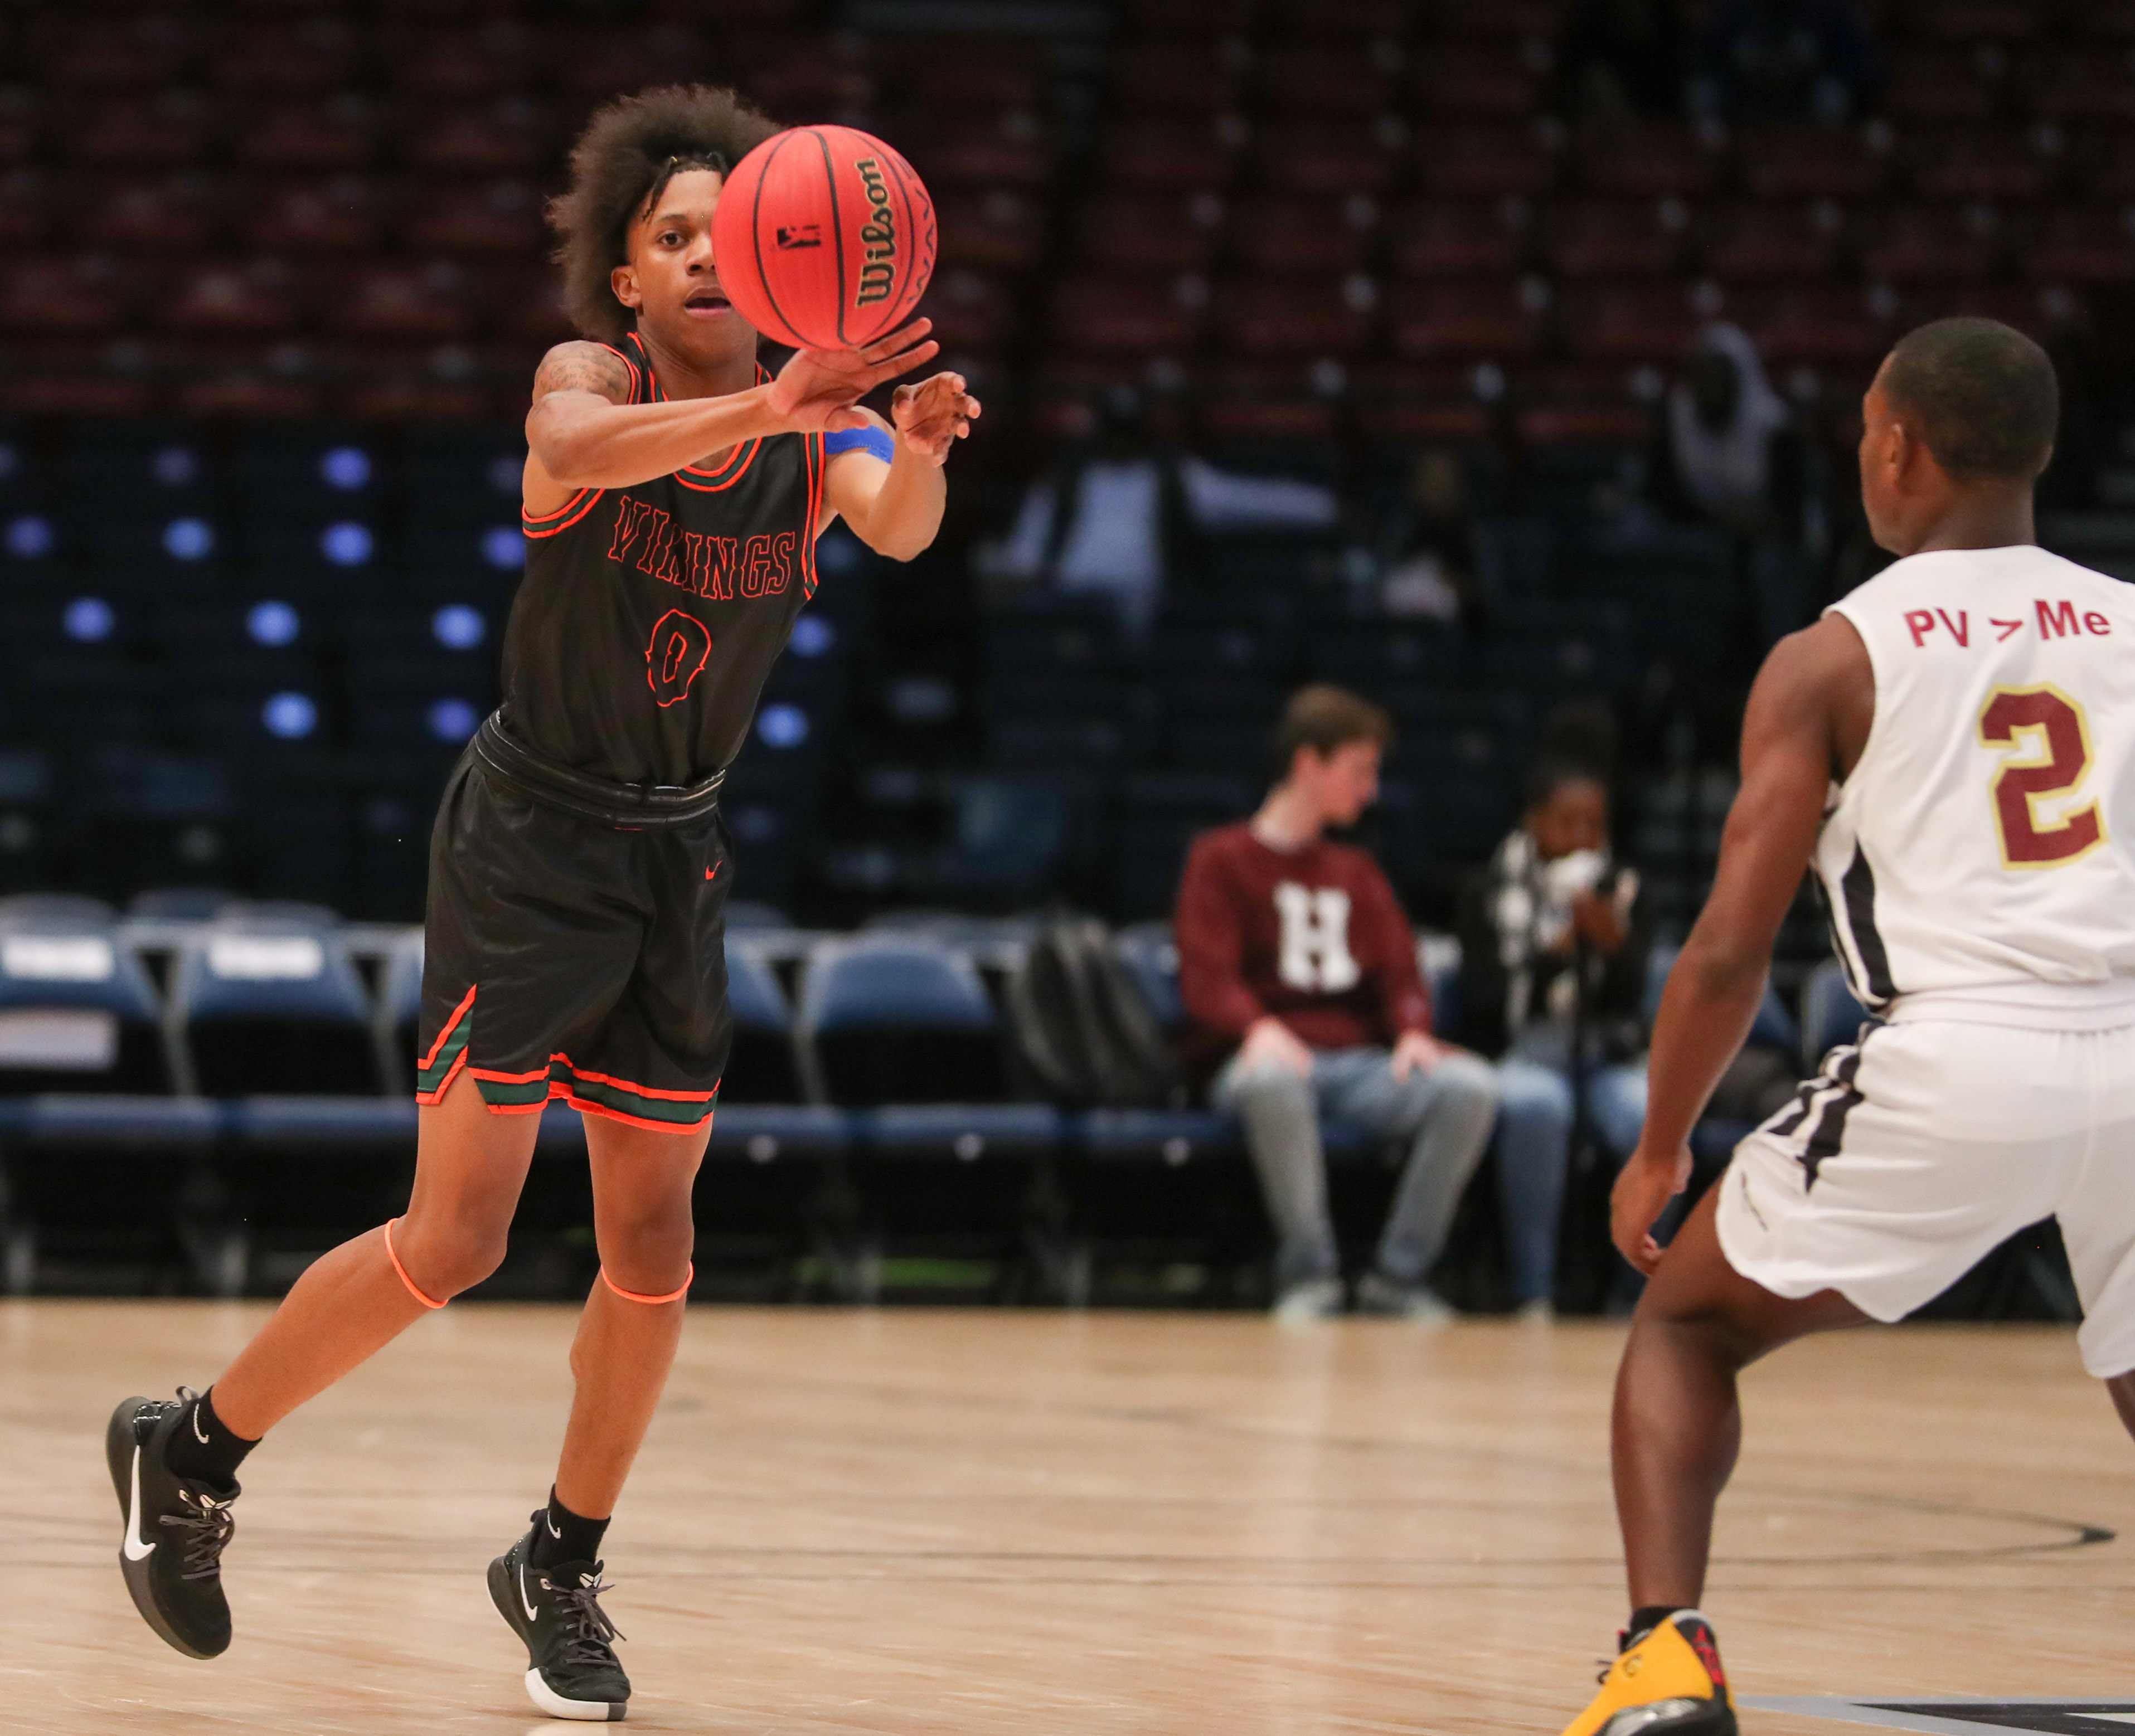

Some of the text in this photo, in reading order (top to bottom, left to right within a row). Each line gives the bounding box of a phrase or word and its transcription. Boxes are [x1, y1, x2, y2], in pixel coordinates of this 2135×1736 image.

[855, 157, 895, 308] Wilson
[608, 495, 795, 600] VIKINGS
[644, 609, 711, 707] 0
[1903, 607, 1969, 648] PV
[2034, 599, 2112, 641] Me
[1977, 681, 2109, 871] 2
[1272, 880, 1361, 994] H
